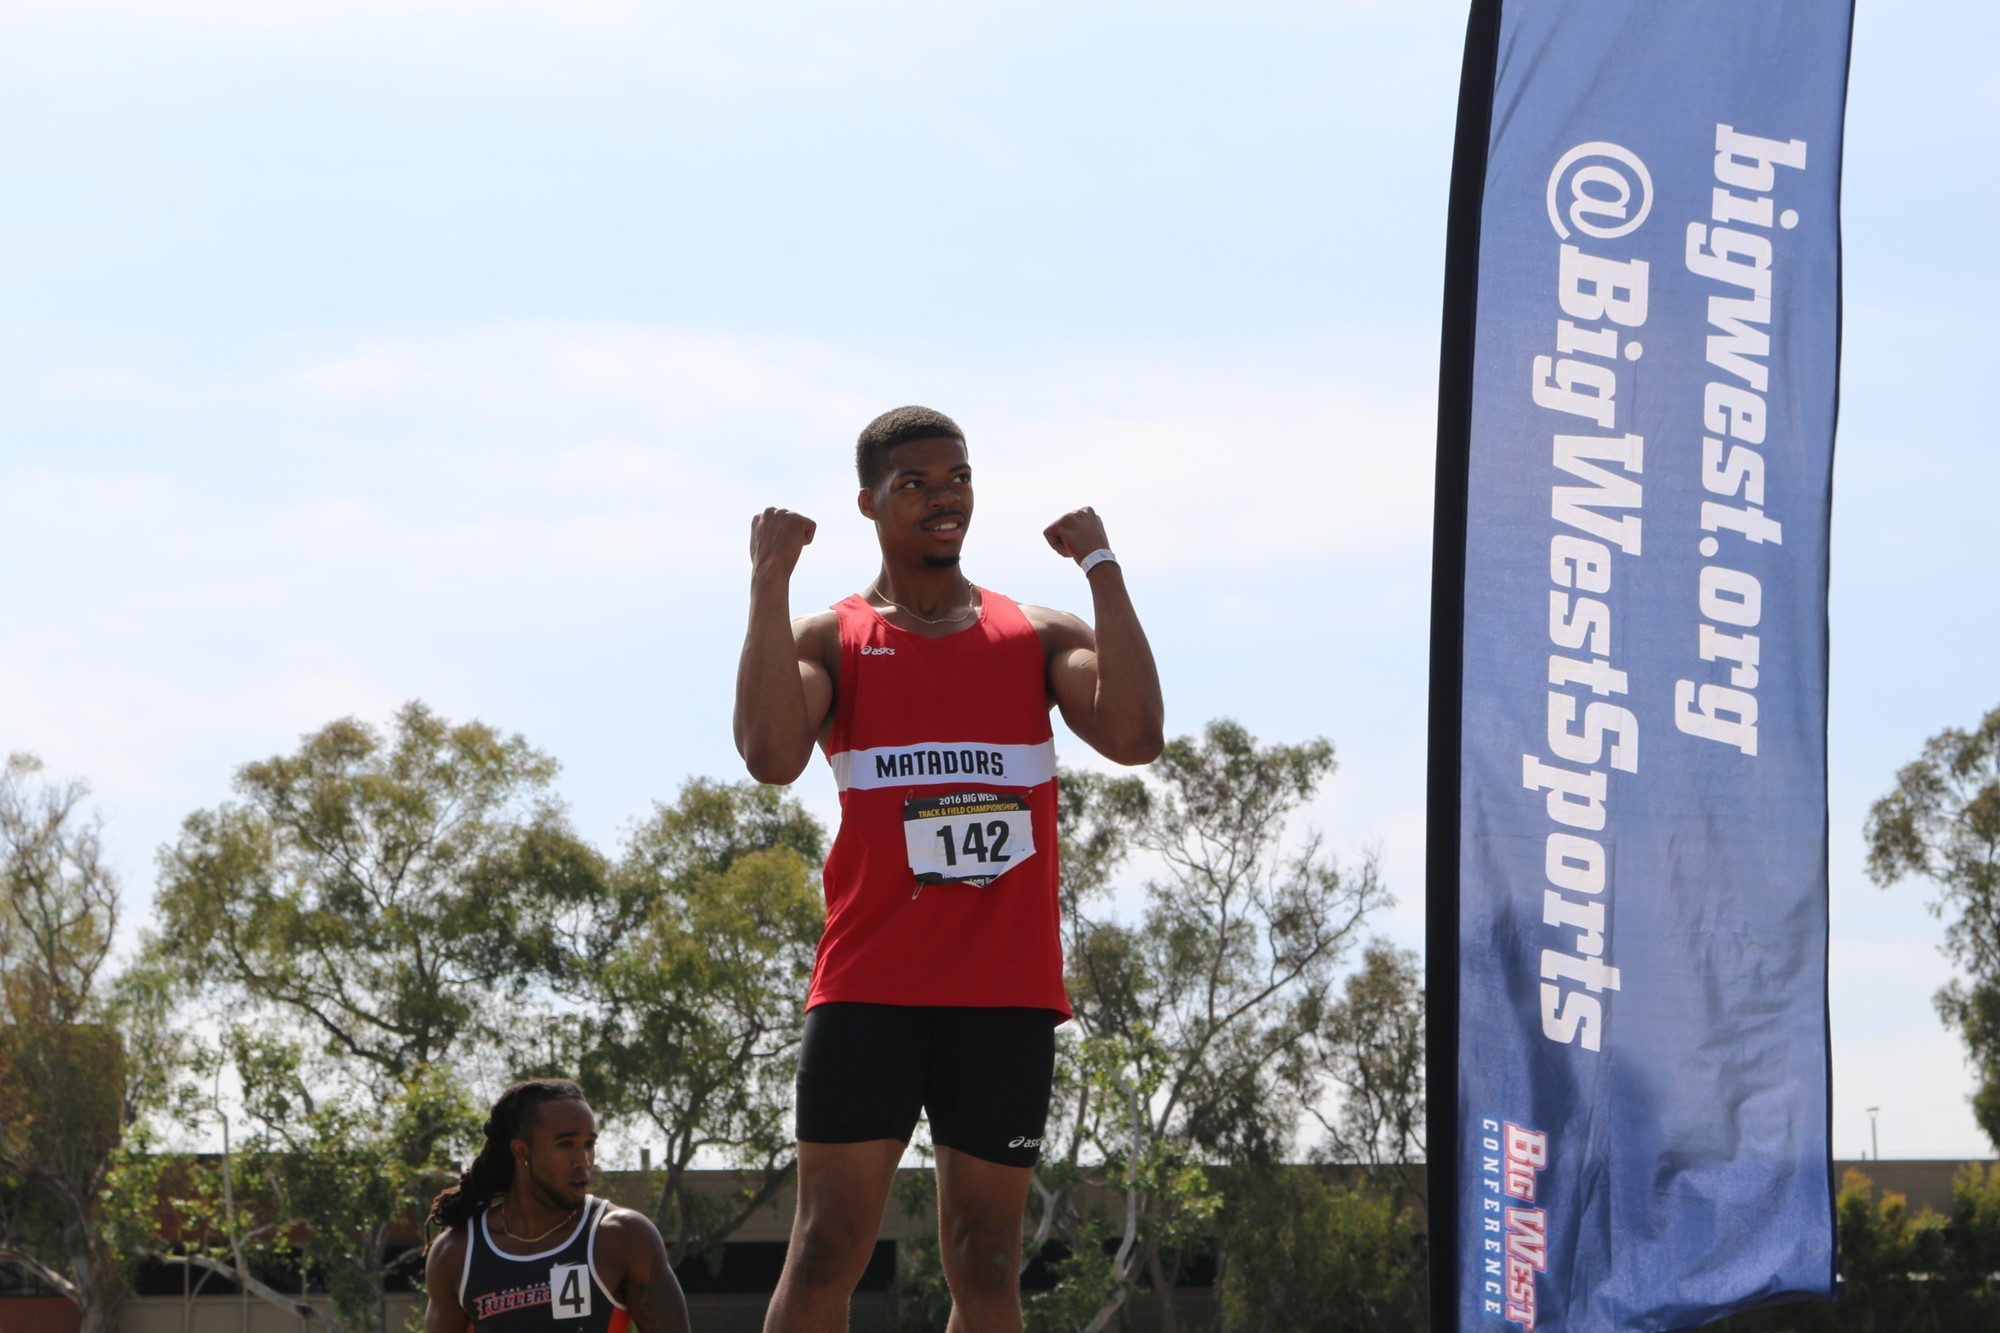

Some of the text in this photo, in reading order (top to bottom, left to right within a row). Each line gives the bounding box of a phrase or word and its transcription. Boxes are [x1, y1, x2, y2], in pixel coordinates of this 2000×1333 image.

[1675, 123, 1807, 756] bigwest.org
[1523, 141, 1653, 1052] @BigWestSports
[871, 646, 896, 656] asics
[875, 750, 1004, 778] MATADORS
[918, 802, 1019, 819] TRACK & FIELD CHAMPIONSHIPS
[939, 794, 961, 806] 2016
[962, 793, 977, 804] BIG
[936, 820, 1012, 866] 142
[1483, 1118, 1501, 1315] CONFERENCE
[474, 1287, 552, 1319] FULLERT
[501, 1281, 552, 1294] CAL STA
[559, 1269, 585, 1315] 4
